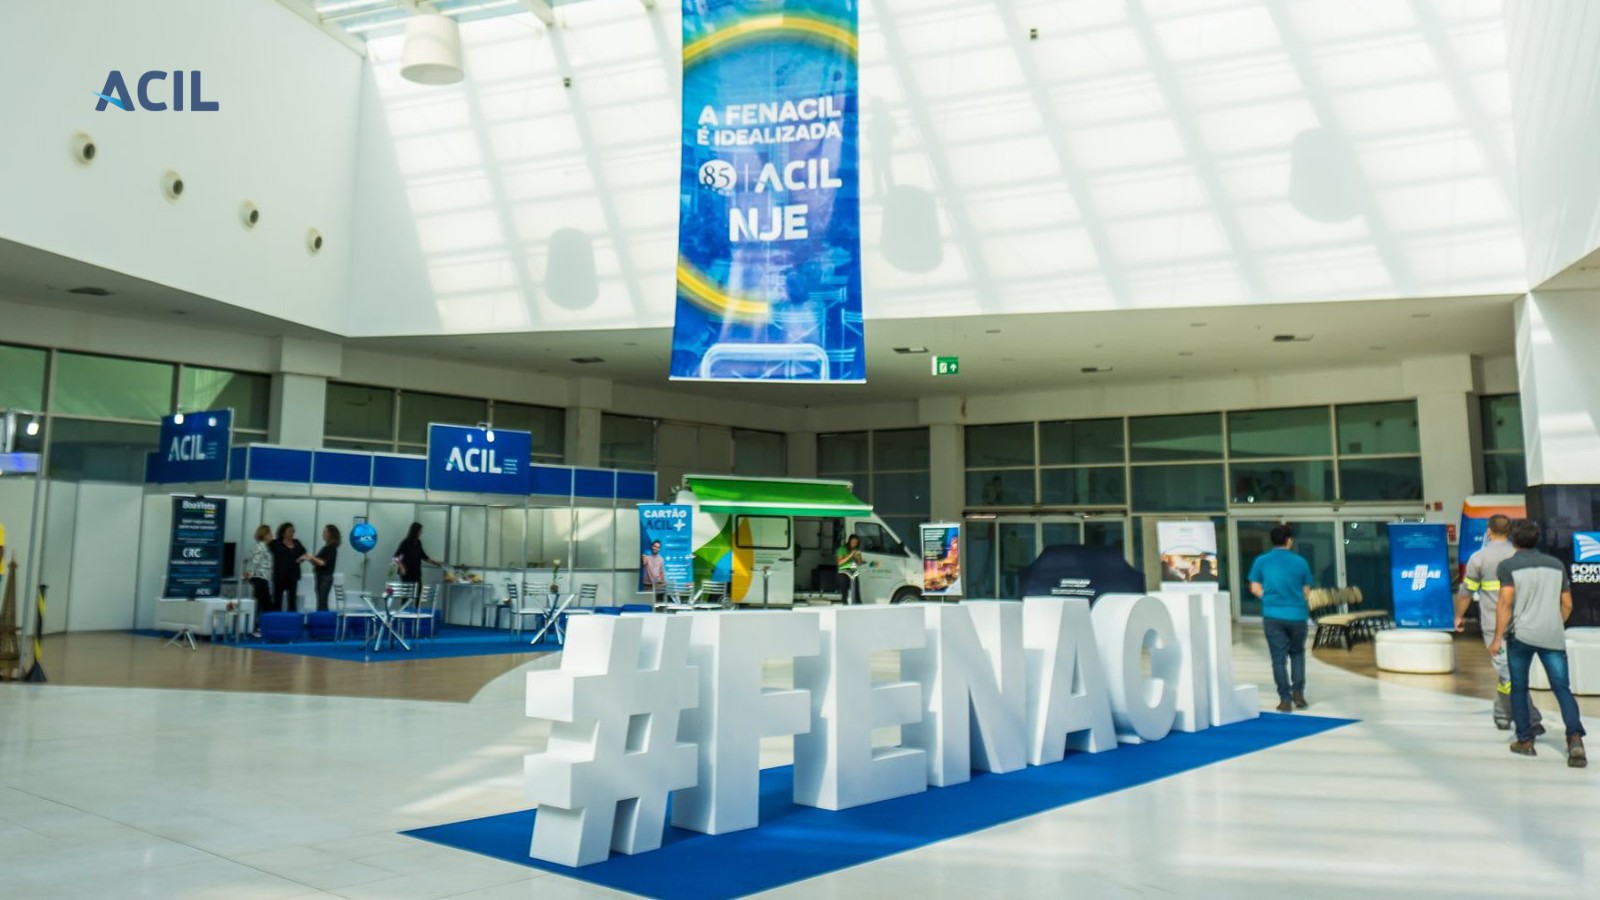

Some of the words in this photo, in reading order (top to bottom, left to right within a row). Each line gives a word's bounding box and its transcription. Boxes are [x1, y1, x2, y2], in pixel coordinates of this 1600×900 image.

[698, 105, 718, 126] A
[726, 95, 842, 126] FENACIL
[696, 125, 709, 146] É
[714, 121, 842, 147] IDEALIZADA
[703, 164, 731, 188] 85
[754, 158, 843, 193] ACIL
[728, 204, 809, 242] NJE
[167, 434, 206, 462] ACIL
[445, 446, 503, 474] ACIL
[643, 508, 688, 518] CARTÃO
[182, 547, 202, 559] CRC
[1571, 573, 1600, 583] SEGU
[523, 591, 1260, 868] #FENACIL
